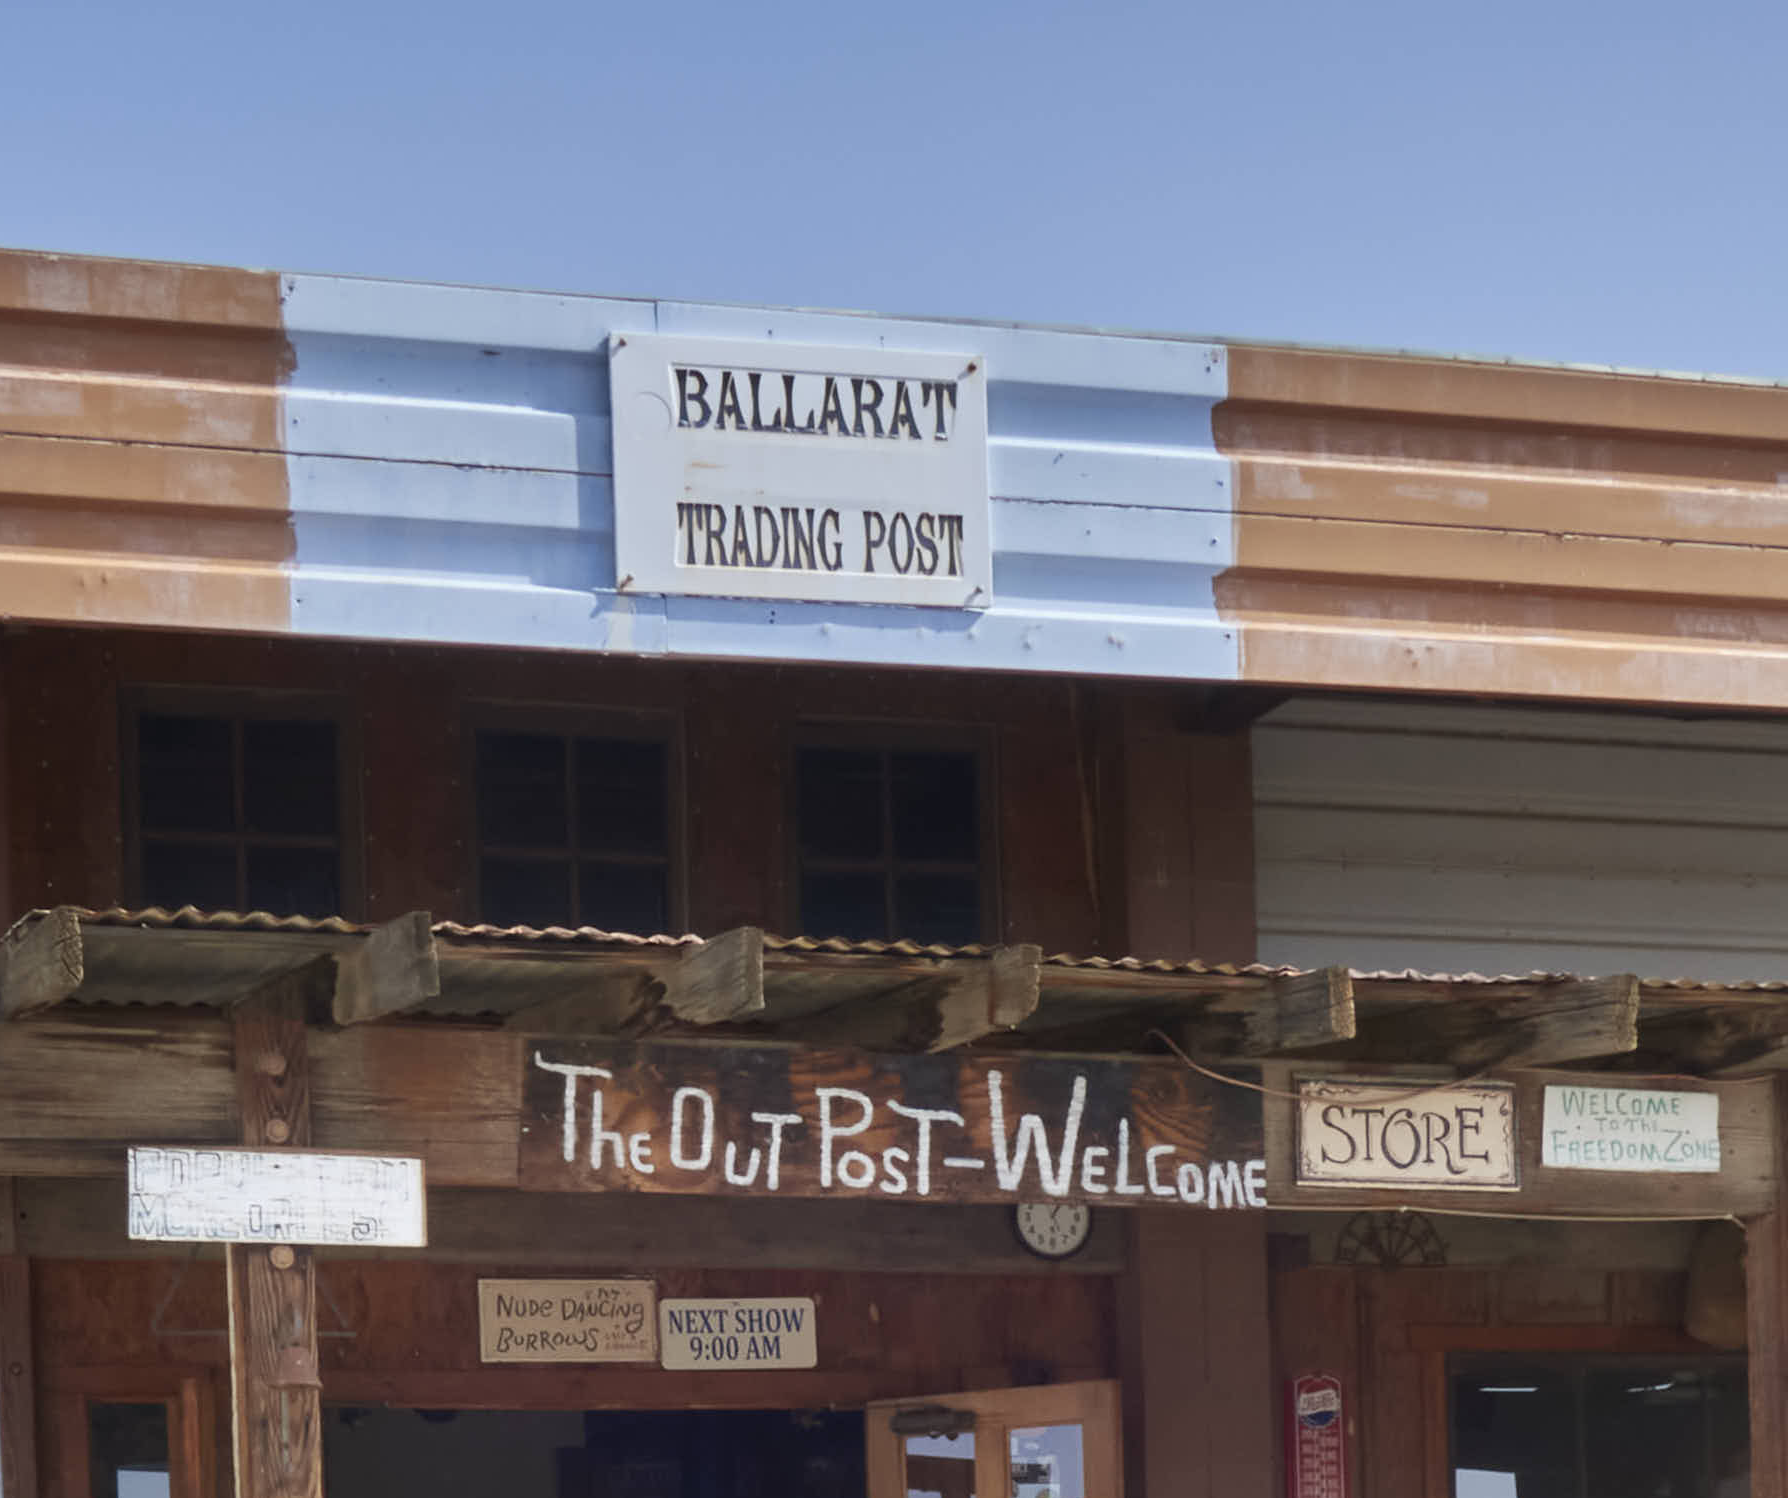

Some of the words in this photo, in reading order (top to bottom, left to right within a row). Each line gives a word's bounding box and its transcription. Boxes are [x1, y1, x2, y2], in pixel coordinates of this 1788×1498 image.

[675, 368, 957, 441] BALLARAT
[676, 502, 844, 572] TRADING
[862, 511, 965, 577] POST
[1562, 1090, 1681, 1117] WELCOME
[1320, 1105, 1490, 1175] STORE
[668, 1309, 729, 1334] NEXT
[735, 1308, 805, 1333] SHOW
[496, 1327, 600, 1352] BURROWS
[690, 1336, 739, 1361] 9:00
[746, 1336, 781, 1360] AM
